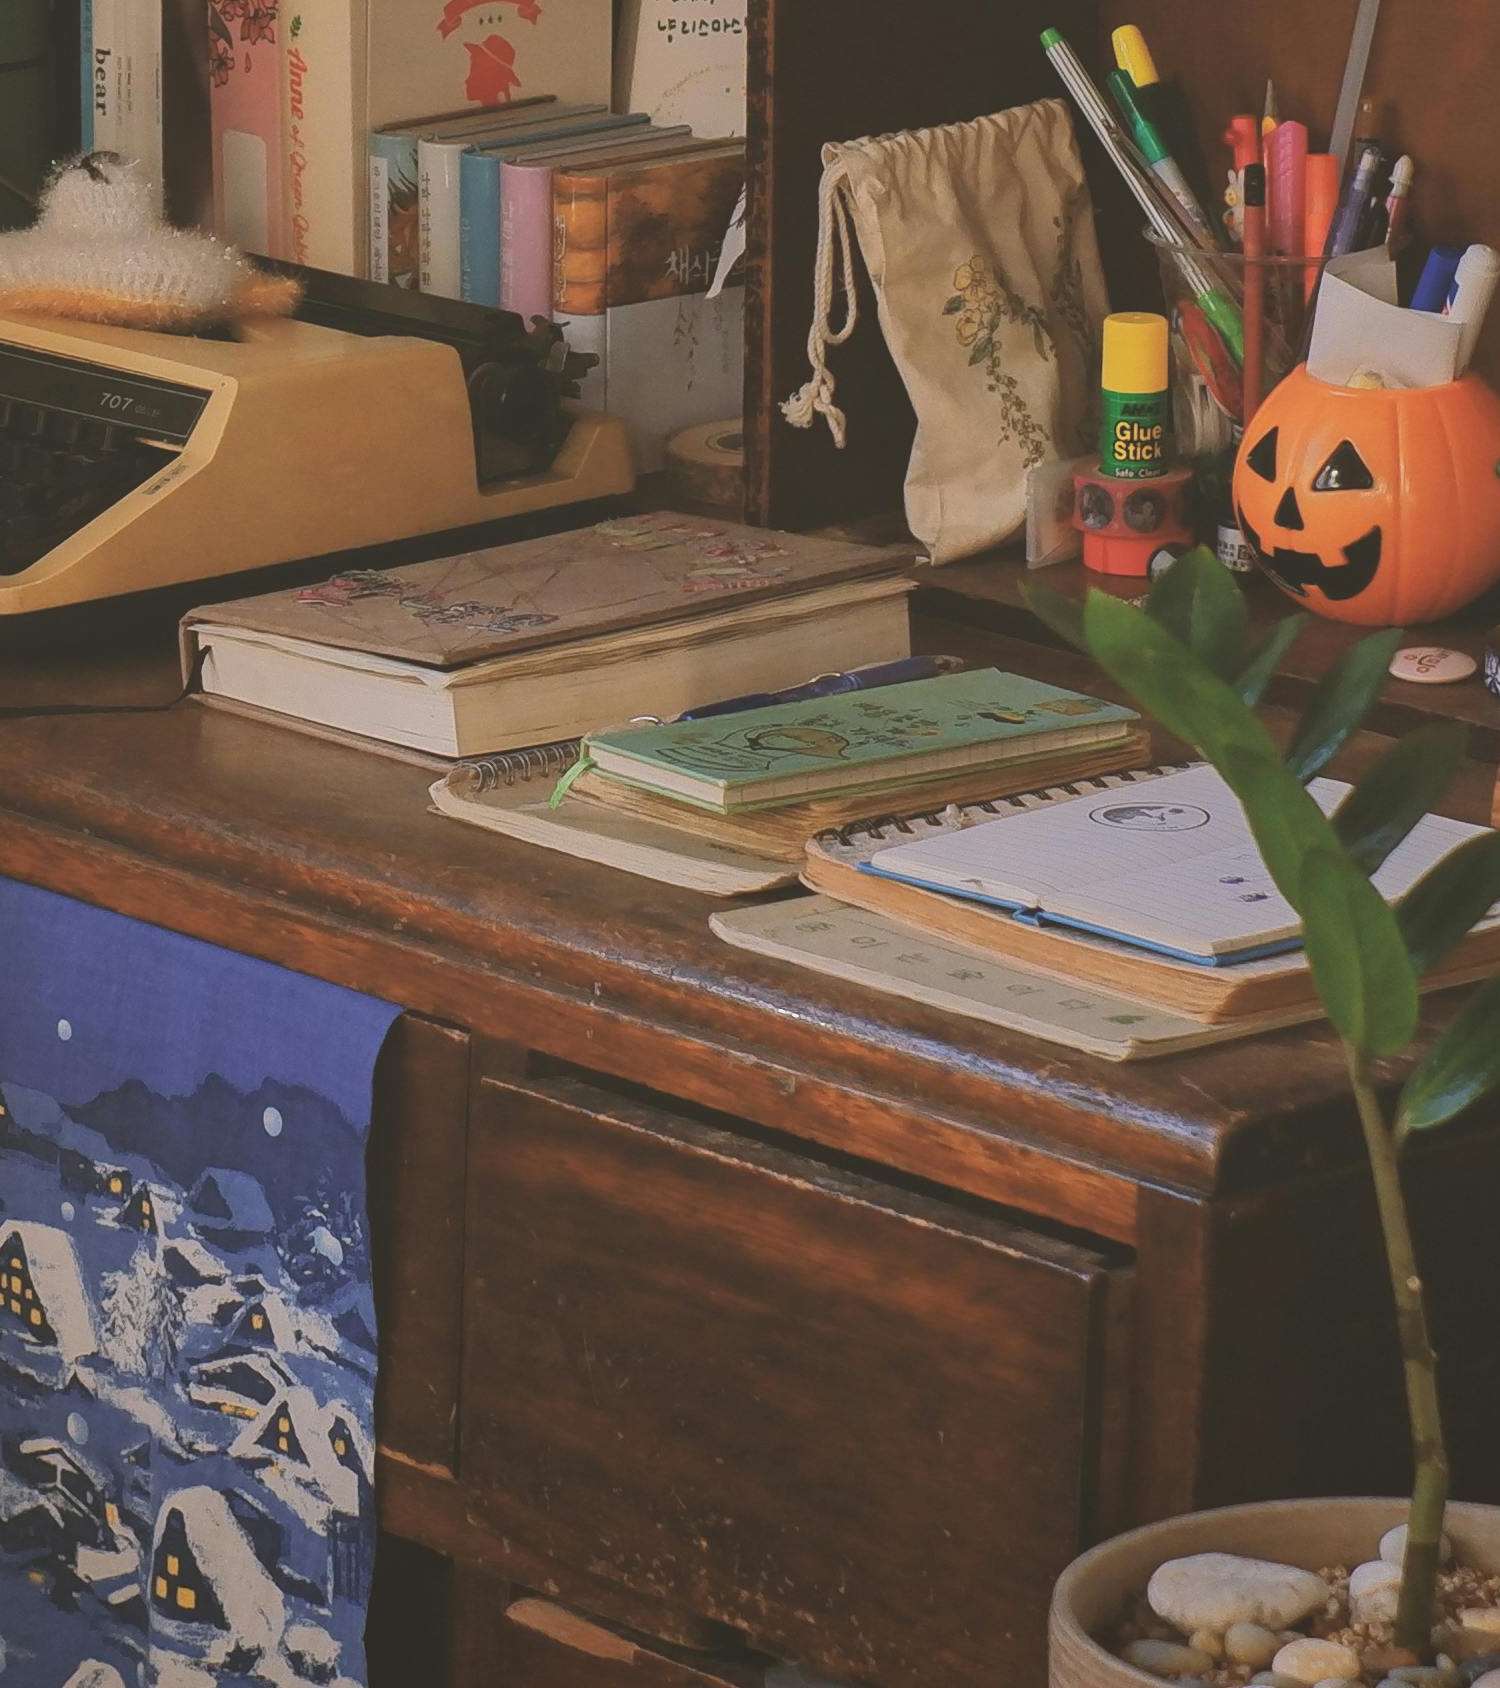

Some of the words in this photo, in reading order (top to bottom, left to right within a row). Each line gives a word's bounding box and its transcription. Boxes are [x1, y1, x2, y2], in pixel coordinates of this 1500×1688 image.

[93, 48, 112, 117] bear
[286, 48, 308, 121] Anne
[291, 124, 306, 149] of
[101, 392, 134, 412] 707
[1115, 421, 1161, 441] Glue
[1114, 442, 1161, 460] Stick
